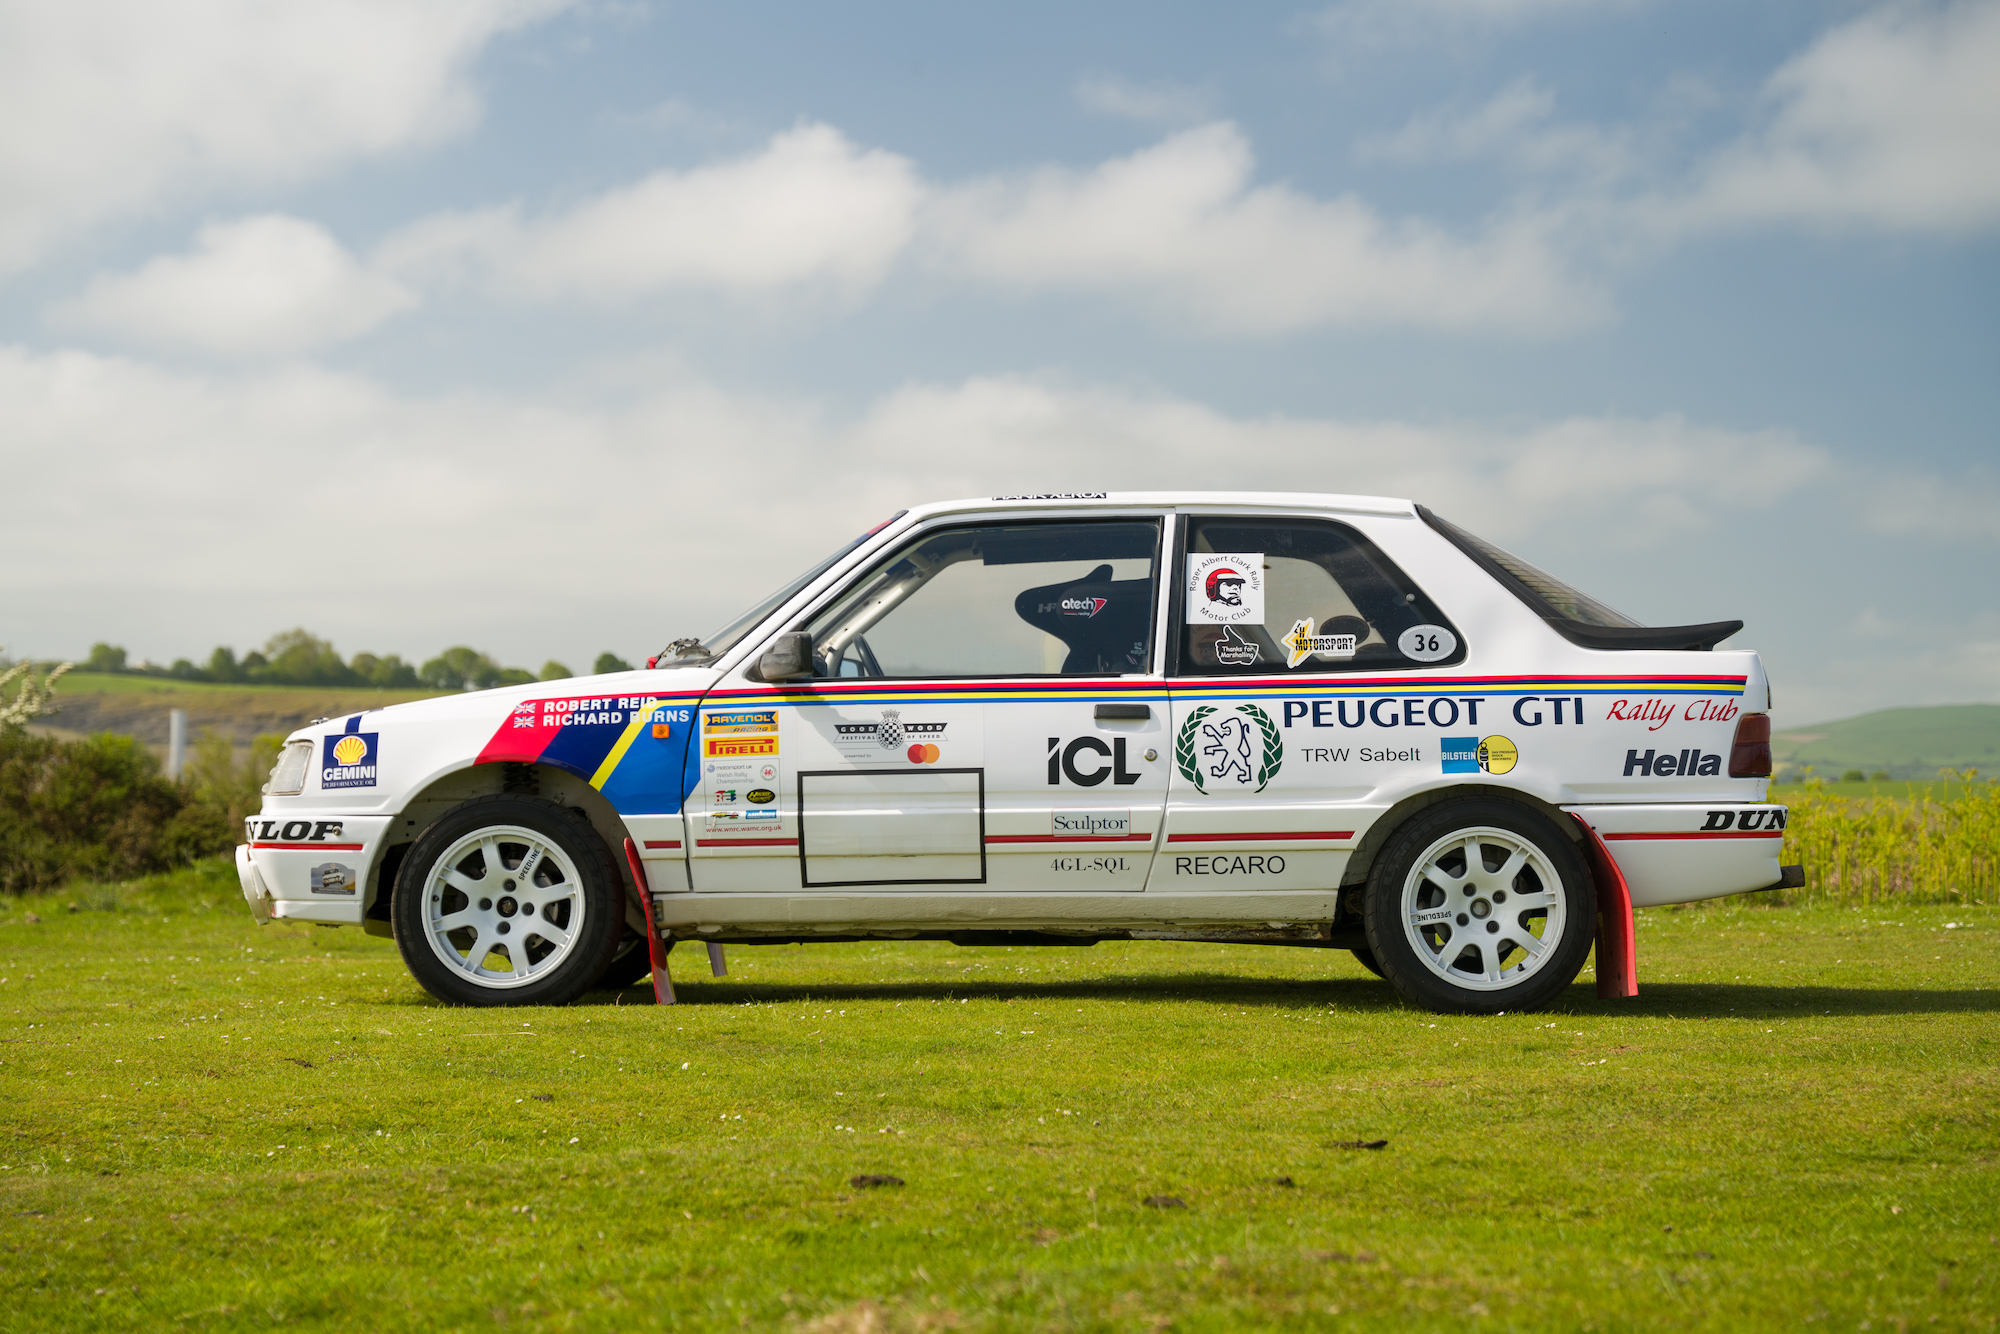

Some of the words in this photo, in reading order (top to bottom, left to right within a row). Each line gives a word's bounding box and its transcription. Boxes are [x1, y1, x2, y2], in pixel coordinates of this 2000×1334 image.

[1189, 567, 1202, 592] Roger
[1201, 556, 1228, 569] Albert
[1230, 556, 1251, 571] Clark
[1249, 570, 1261, 591] Rally
[1061, 597, 1094, 609] atech
[1199, 607, 1228, 622] Motor
[1231, 607, 1252, 621] Club
[1295, 637, 1353, 651] MOTORSPORT
[1415, 634, 1439, 652] 36
[1220, 651, 1254, 660] Marshalling
[544, 699, 612, 713] ROBERT
[617, 697, 657, 709] REID
[1283, 697, 1485, 728] PEUGEOT
[1512, 696, 1583, 725] GTI
[543, 712, 623, 727] RICHARD
[629, 710, 690, 723] BURNS
[711, 714, 771, 724] RAVENOL
[1606, 698, 1676, 731] Rally
[1684, 697, 1739, 722] Club
[709, 738, 774, 755] PIRELLI
[1300, 748, 1350, 762] TRW
[1359, 747, 1421, 762] Sabelt
[1442, 751, 1476, 761] BILSTEIN
[1622, 749, 1722, 777] Hella
[323, 765, 376, 782] GEMINI
[706, 824, 782, 833] www.wnrc.wamc.org.uk
[1053, 815, 1128, 835] Sculptor
[518, 848, 541, 881] SPEEDLINE
[1050, 858, 1131, 874] 4GL-SQL
[1176, 855, 1286, 875] RECARO
[1416, 911, 1453, 922] SPEEDLINE
